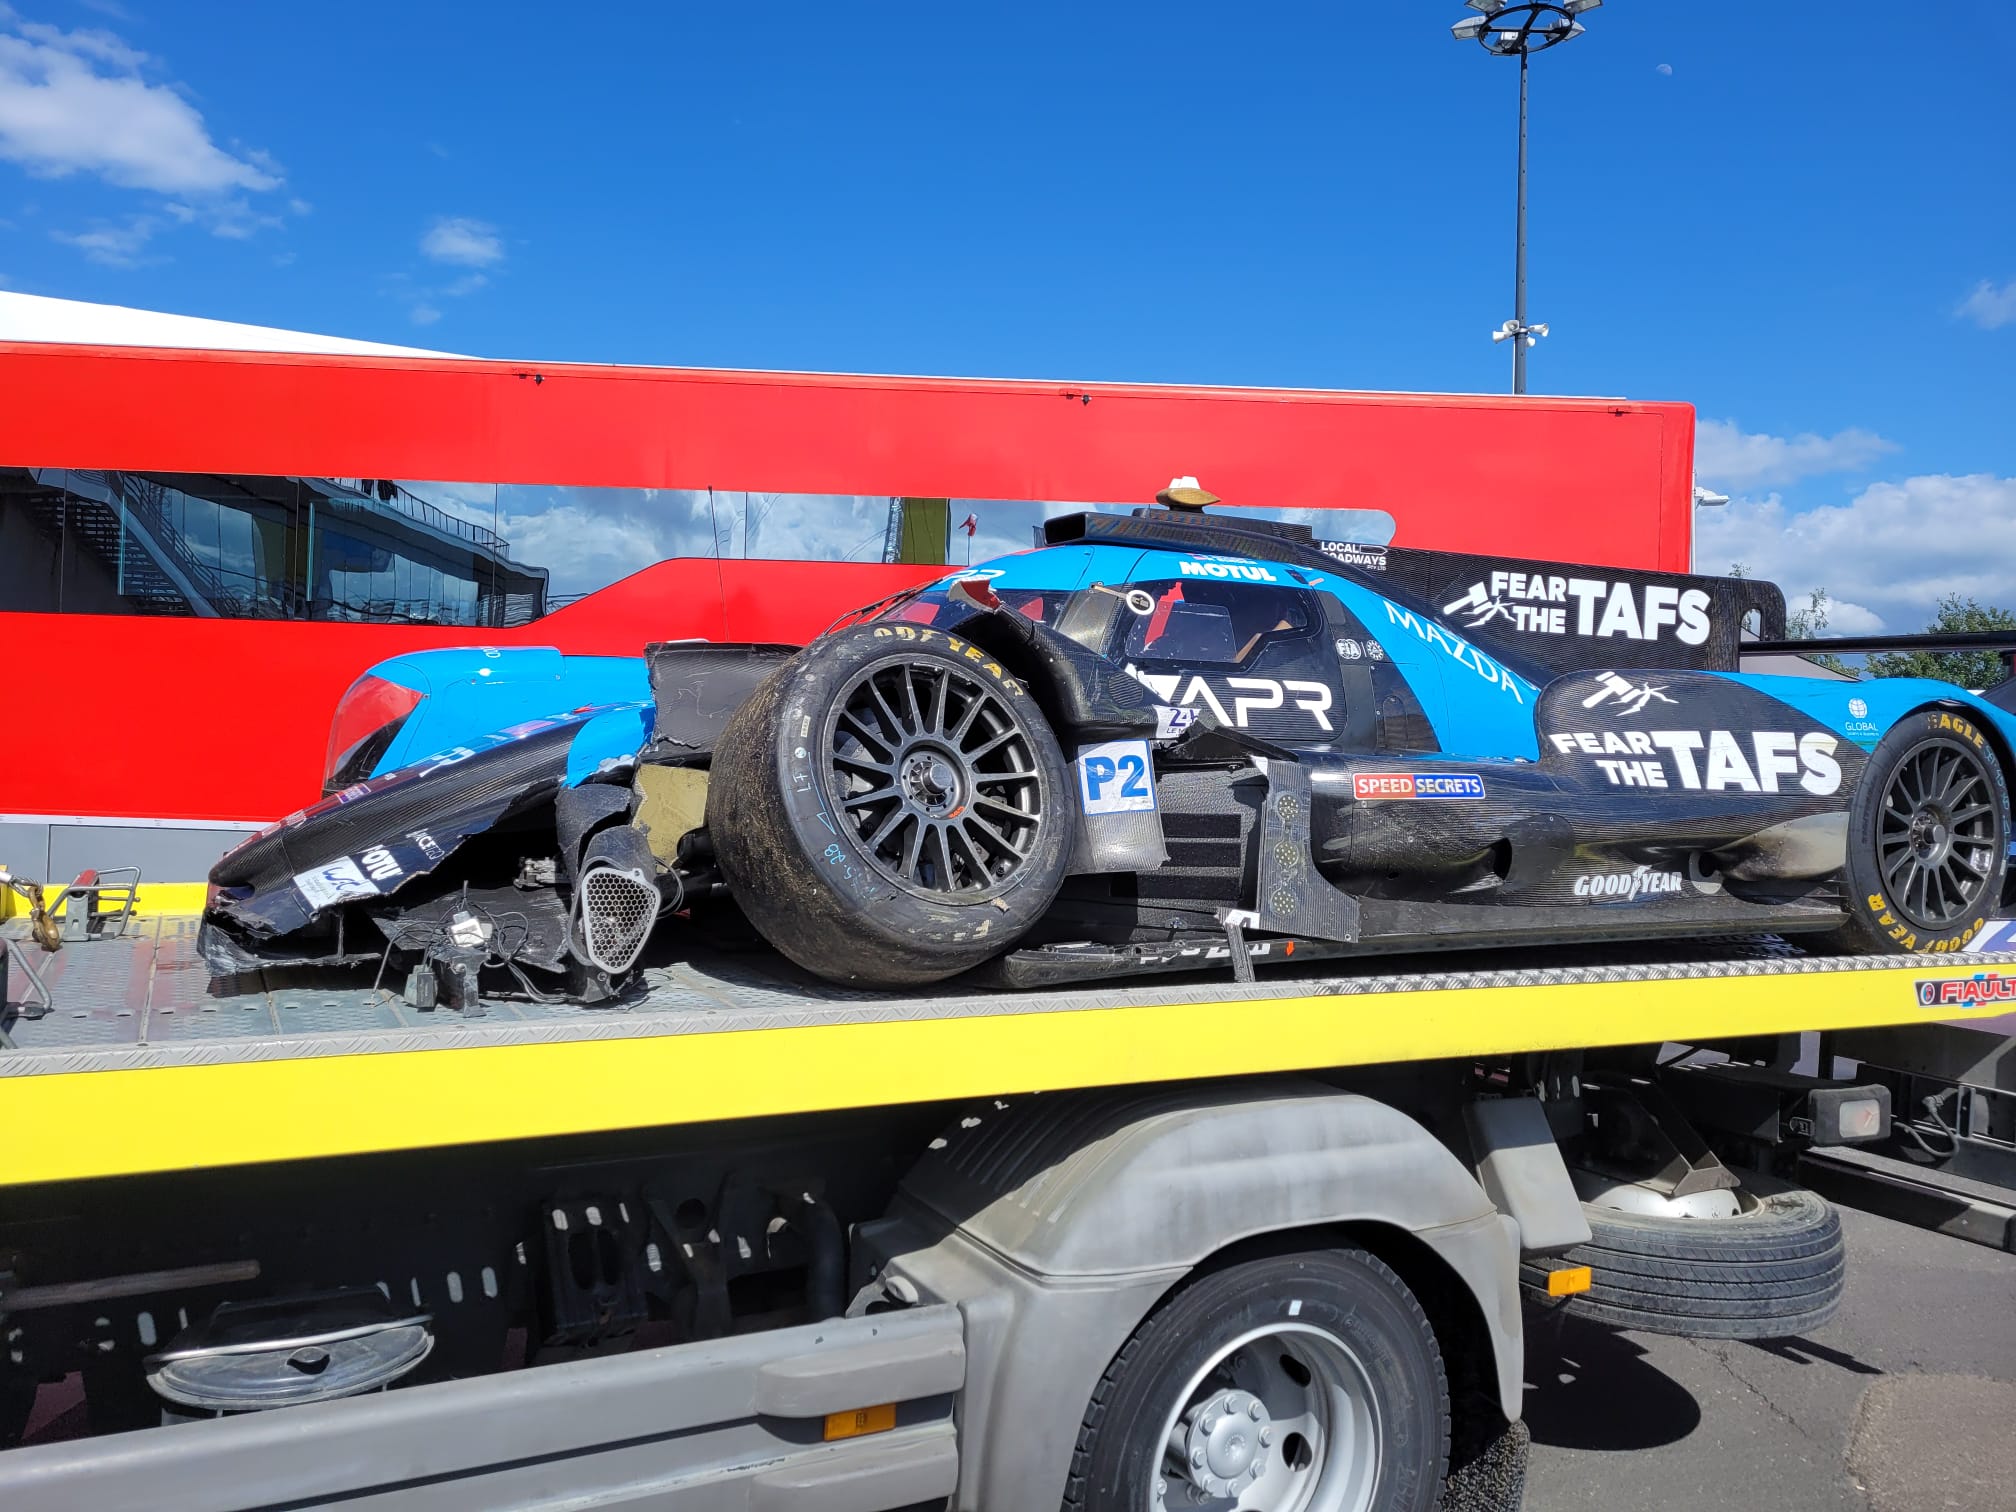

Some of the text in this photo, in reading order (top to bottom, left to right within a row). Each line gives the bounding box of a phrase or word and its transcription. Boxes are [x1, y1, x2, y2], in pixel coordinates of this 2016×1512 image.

[1321, 541, 1361, 554] LOCAL
[1179, 561, 1278, 582] MOTUL
[1491, 571, 1567, 602] FEAR
[1512, 605, 1566, 634] THE
[1568, 578, 1712, 646] TAFS
[1383, 600, 1524, 705] MAZDA
[1180, 675, 1335, 731] APR
[1845, 721, 1879, 732] GLOBAL
[1549, 731, 1657, 755] FEAR
[1084, 754, 1149, 801] P2
[1594, 759, 1669, 788] THE
[1650, 730, 1842, 796] TAFS
[1358, 778, 1481, 794] SPEED SECRETS
[1574, 868, 1683, 899] GOODYEAR
